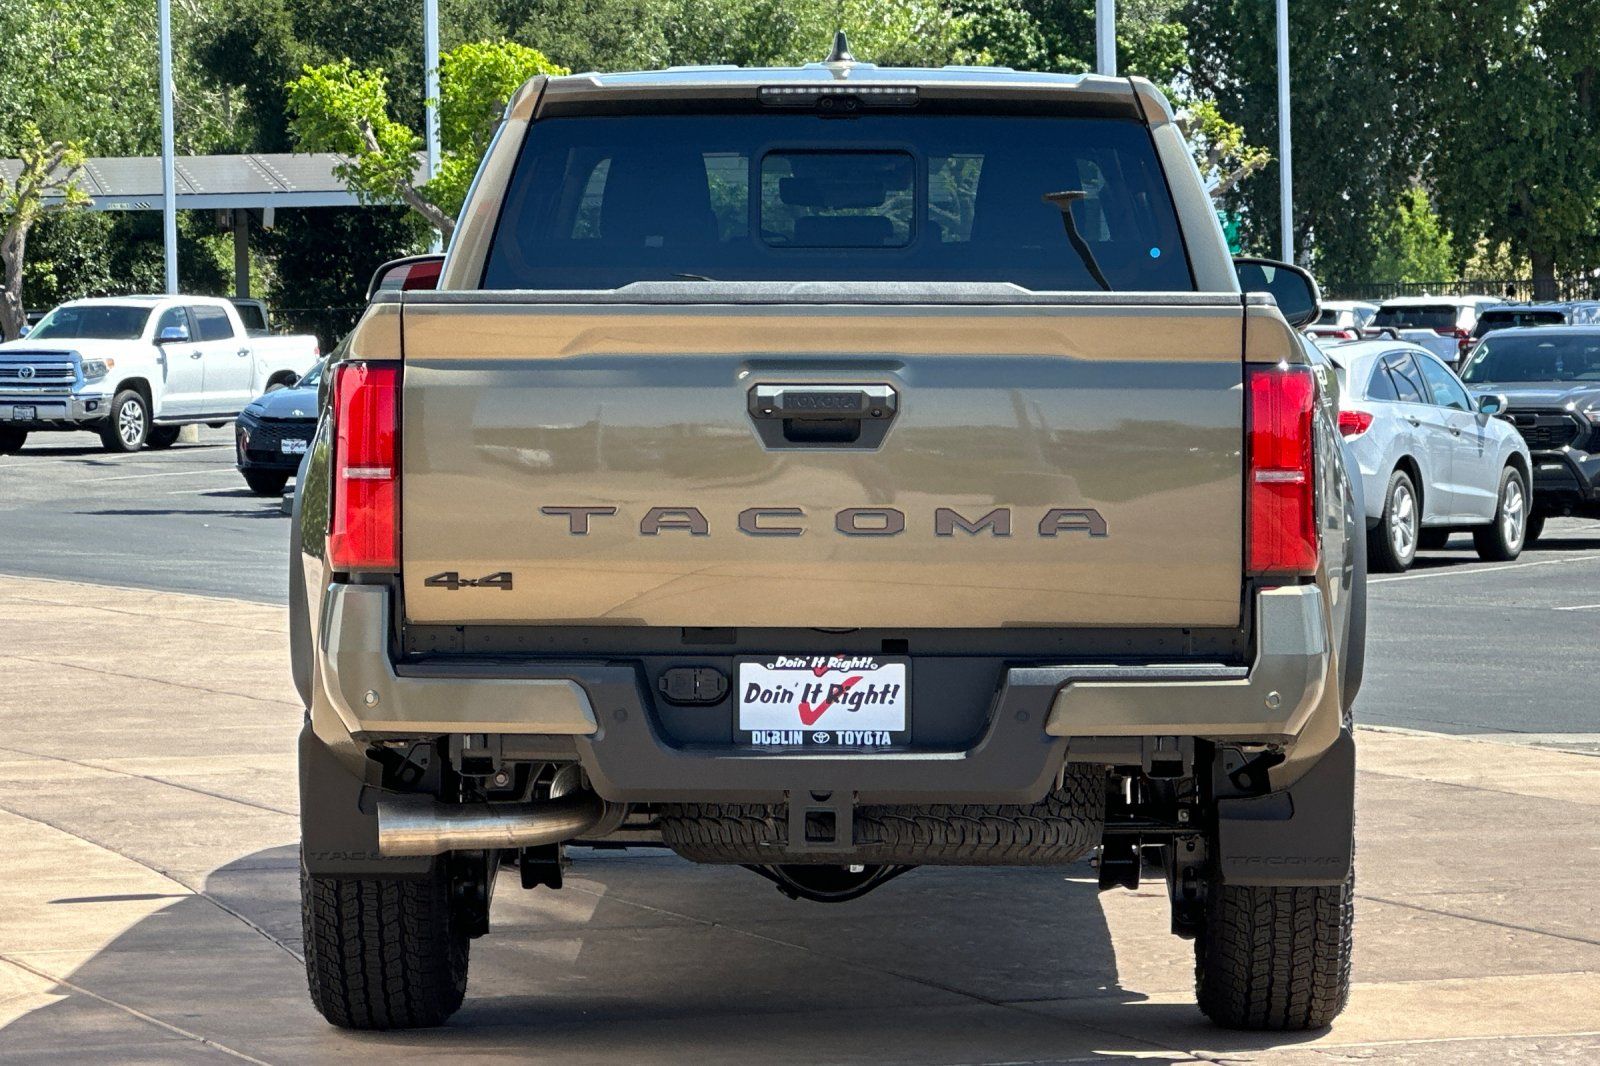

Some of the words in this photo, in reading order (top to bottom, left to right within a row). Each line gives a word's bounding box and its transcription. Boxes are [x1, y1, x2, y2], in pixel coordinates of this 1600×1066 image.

[540, 506, 1110, 537] TACOMA
[424, 571, 513, 591] 4x4
[775, 655, 810, 669] Doin'
[811, 656, 825, 669] It
[827, 656, 873, 673] Right!
[744, 682, 799, 704] Doin'
[801, 683, 822, 704] It
[826, 683, 900, 712] Right!
[752, 730, 803, 745] DUBLIN
[836, 731, 892, 745] TOYOTA
[1226, 855, 1342, 865] TACOMA
